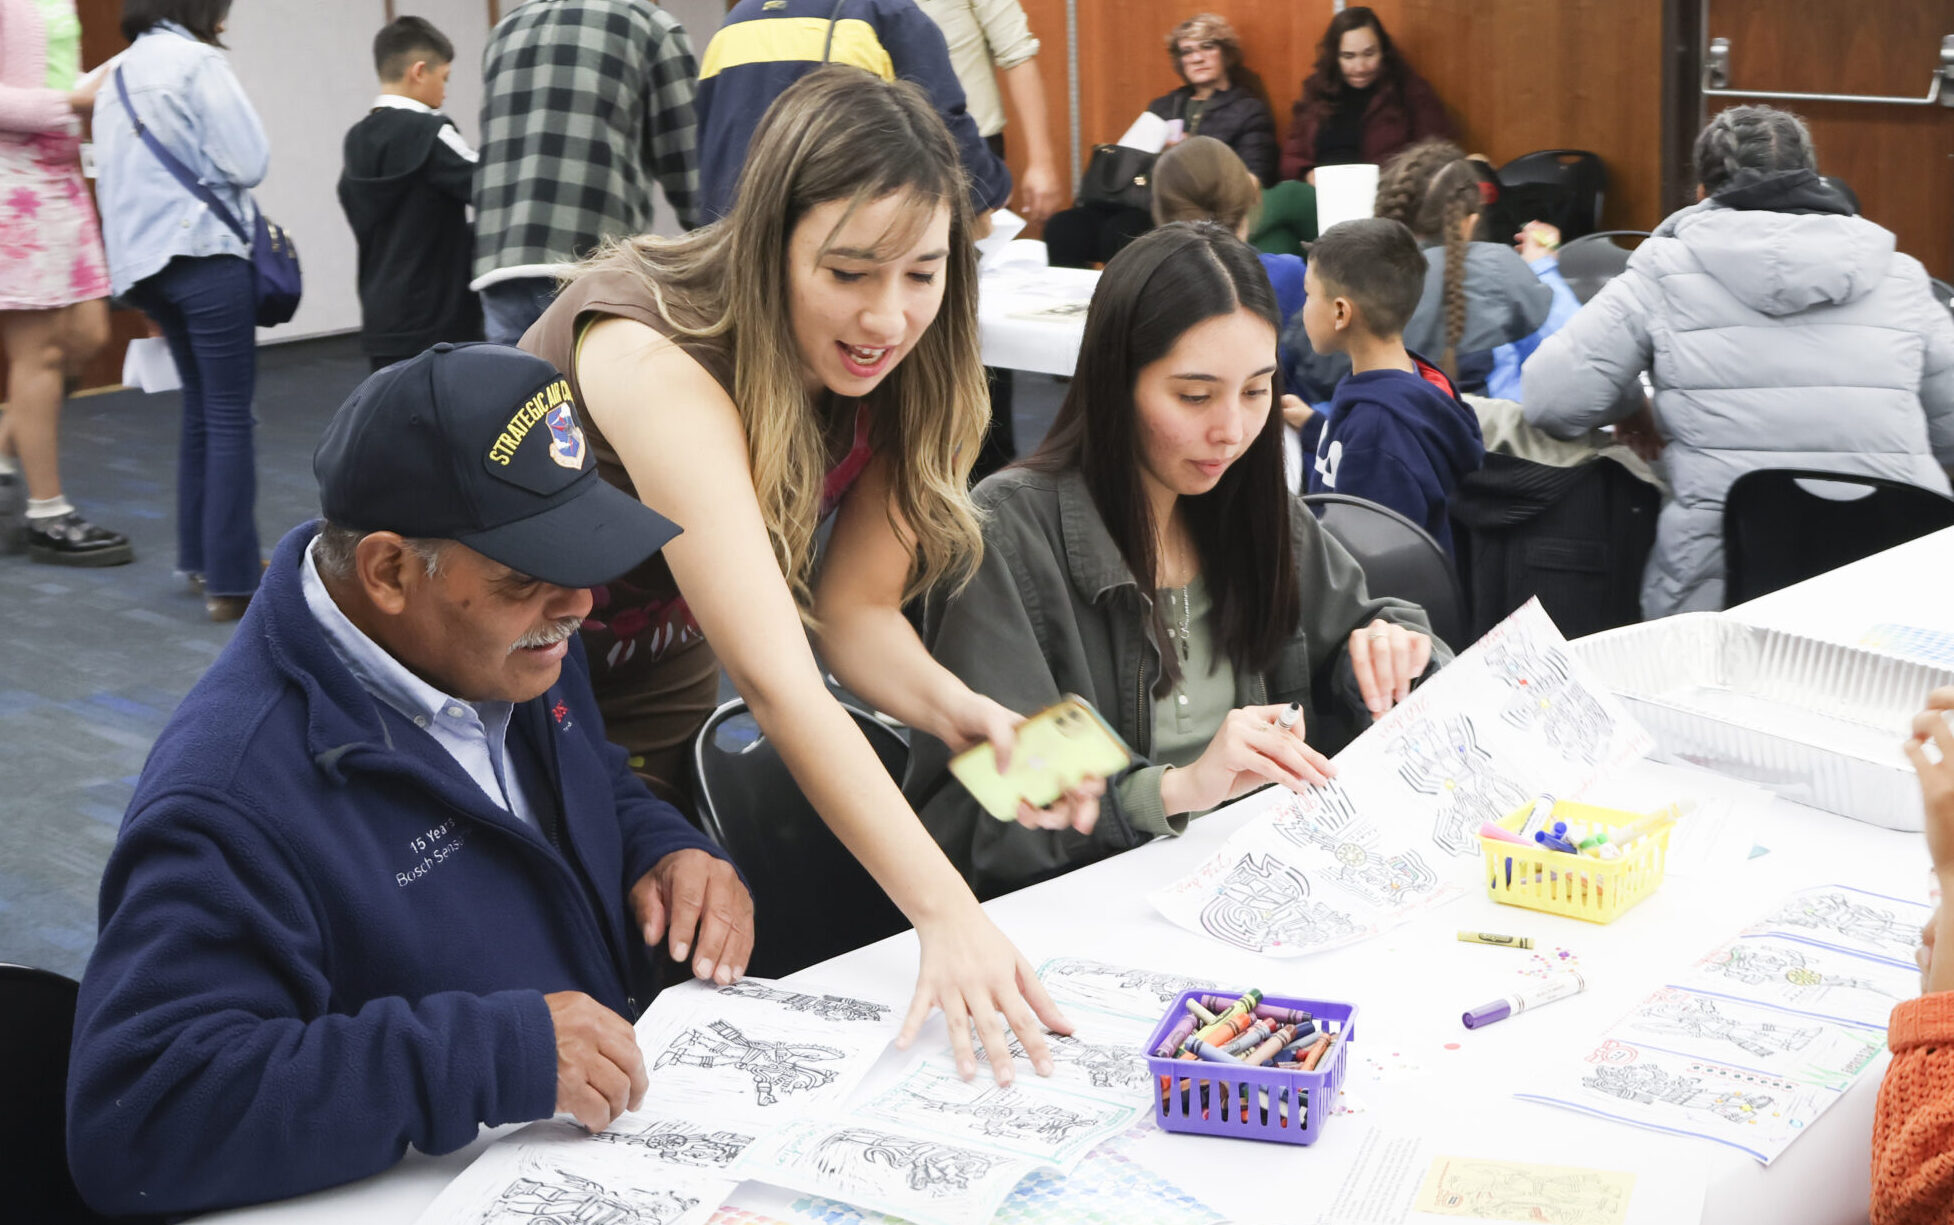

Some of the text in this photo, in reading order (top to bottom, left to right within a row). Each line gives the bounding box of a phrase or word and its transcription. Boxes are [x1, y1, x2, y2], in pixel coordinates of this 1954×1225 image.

[489, 391, 548, 466] STRATEGIC
[546, 382, 562, 408] AIR
[410, 817, 456, 854] 15 Years
[395, 856, 434, 887] Bosch
